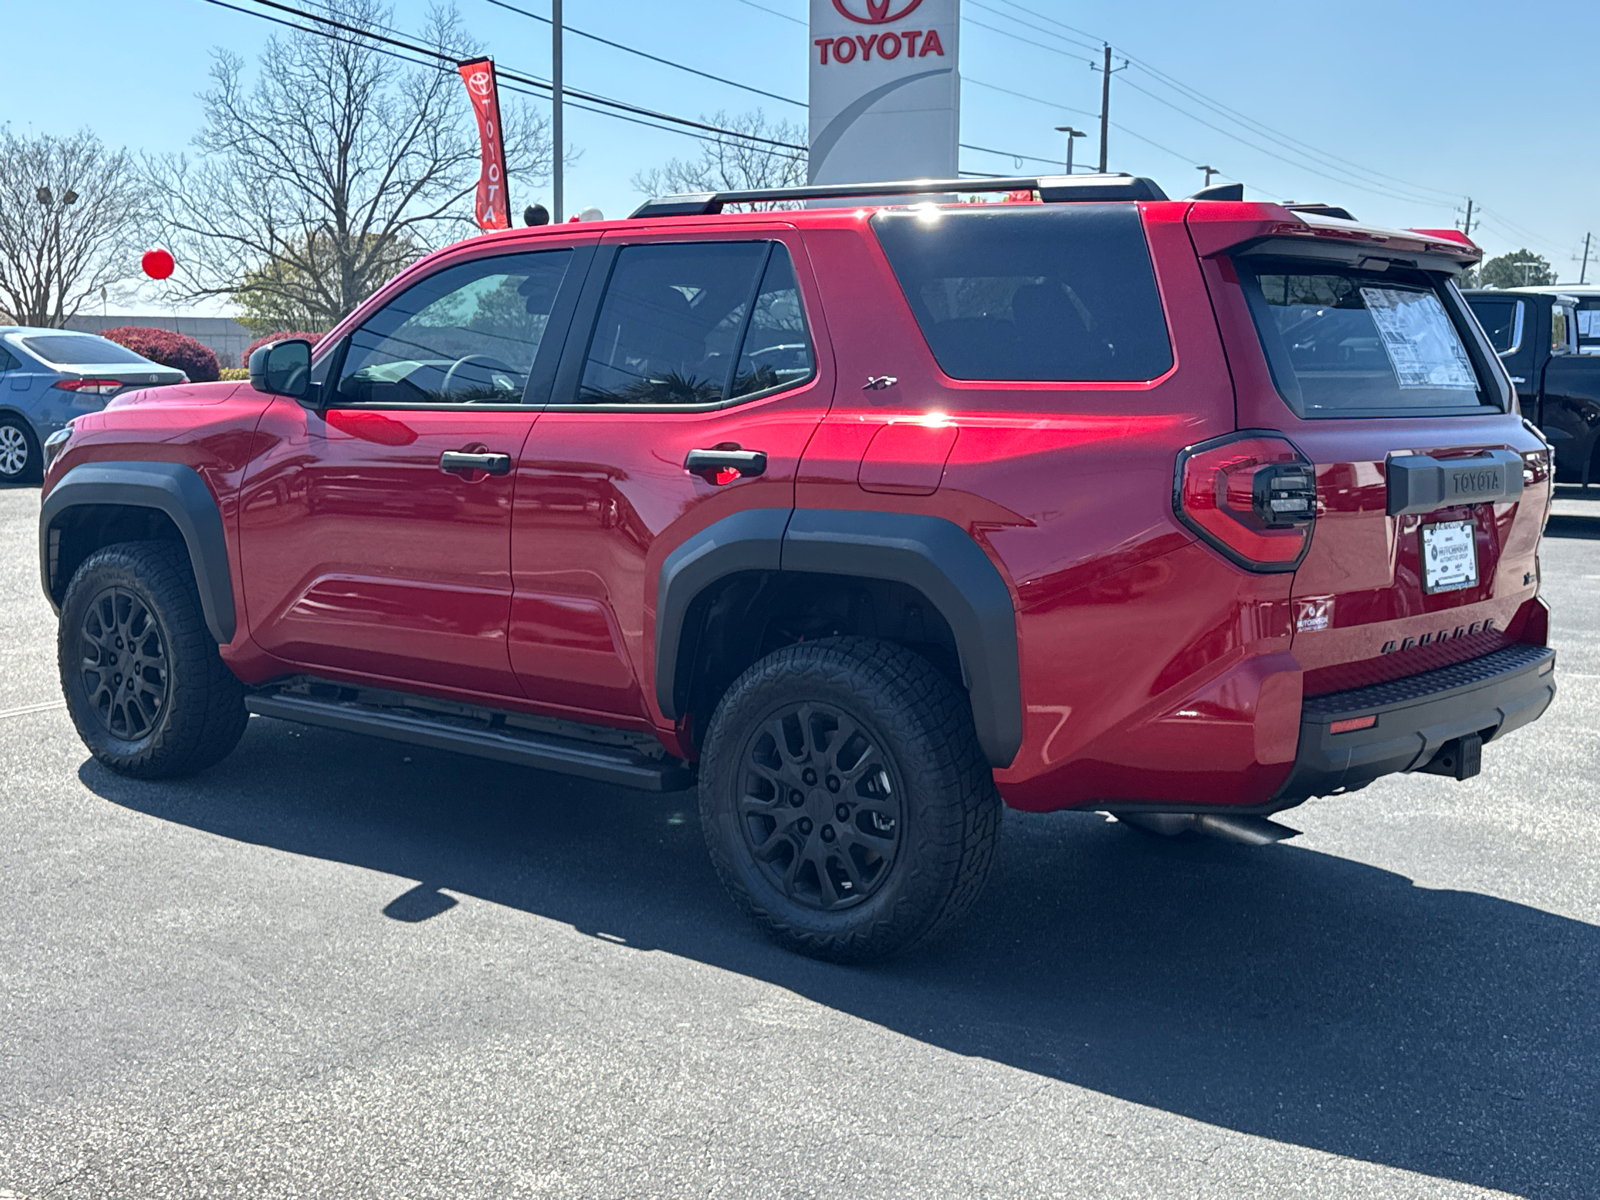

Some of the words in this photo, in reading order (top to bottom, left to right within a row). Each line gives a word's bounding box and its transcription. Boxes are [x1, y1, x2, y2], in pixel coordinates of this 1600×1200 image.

[814, 30, 944, 65] TOYOTA
[481, 98, 499, 223] TOYOTA
[1453, 470, 1500, 494] TOYOTA
[1380, 618, 1495, 654] 4RUNNER
